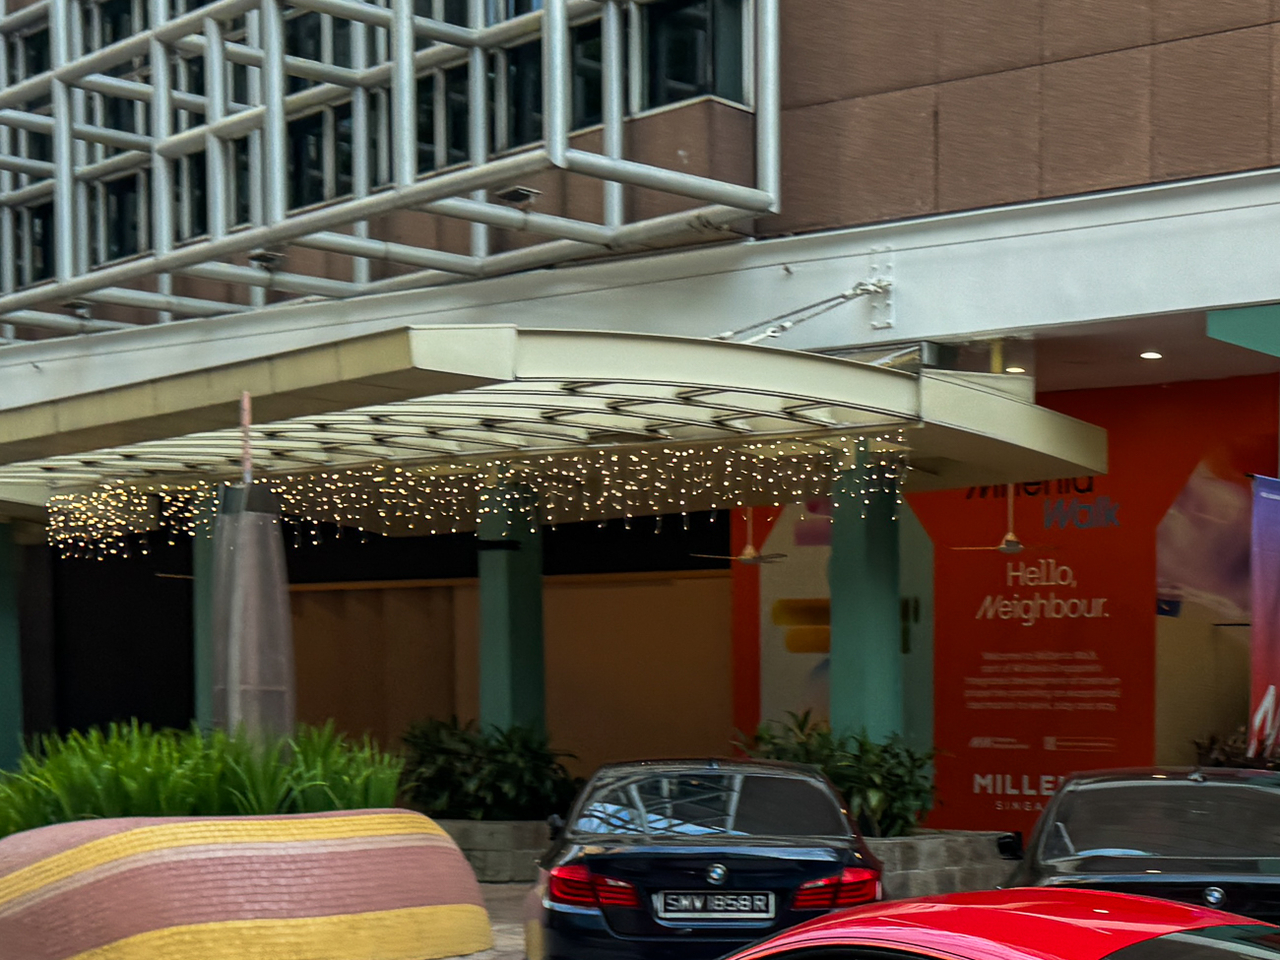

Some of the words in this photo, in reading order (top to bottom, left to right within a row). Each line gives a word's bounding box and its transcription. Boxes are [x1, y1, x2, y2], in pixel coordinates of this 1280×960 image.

[1044, 495, 1120, 529] Walk
[1006, 559, 1077, 587] Hello,
[975, 592, 1109, 626] Neighbour.
[973, 773, 1065, 796] MILLE
